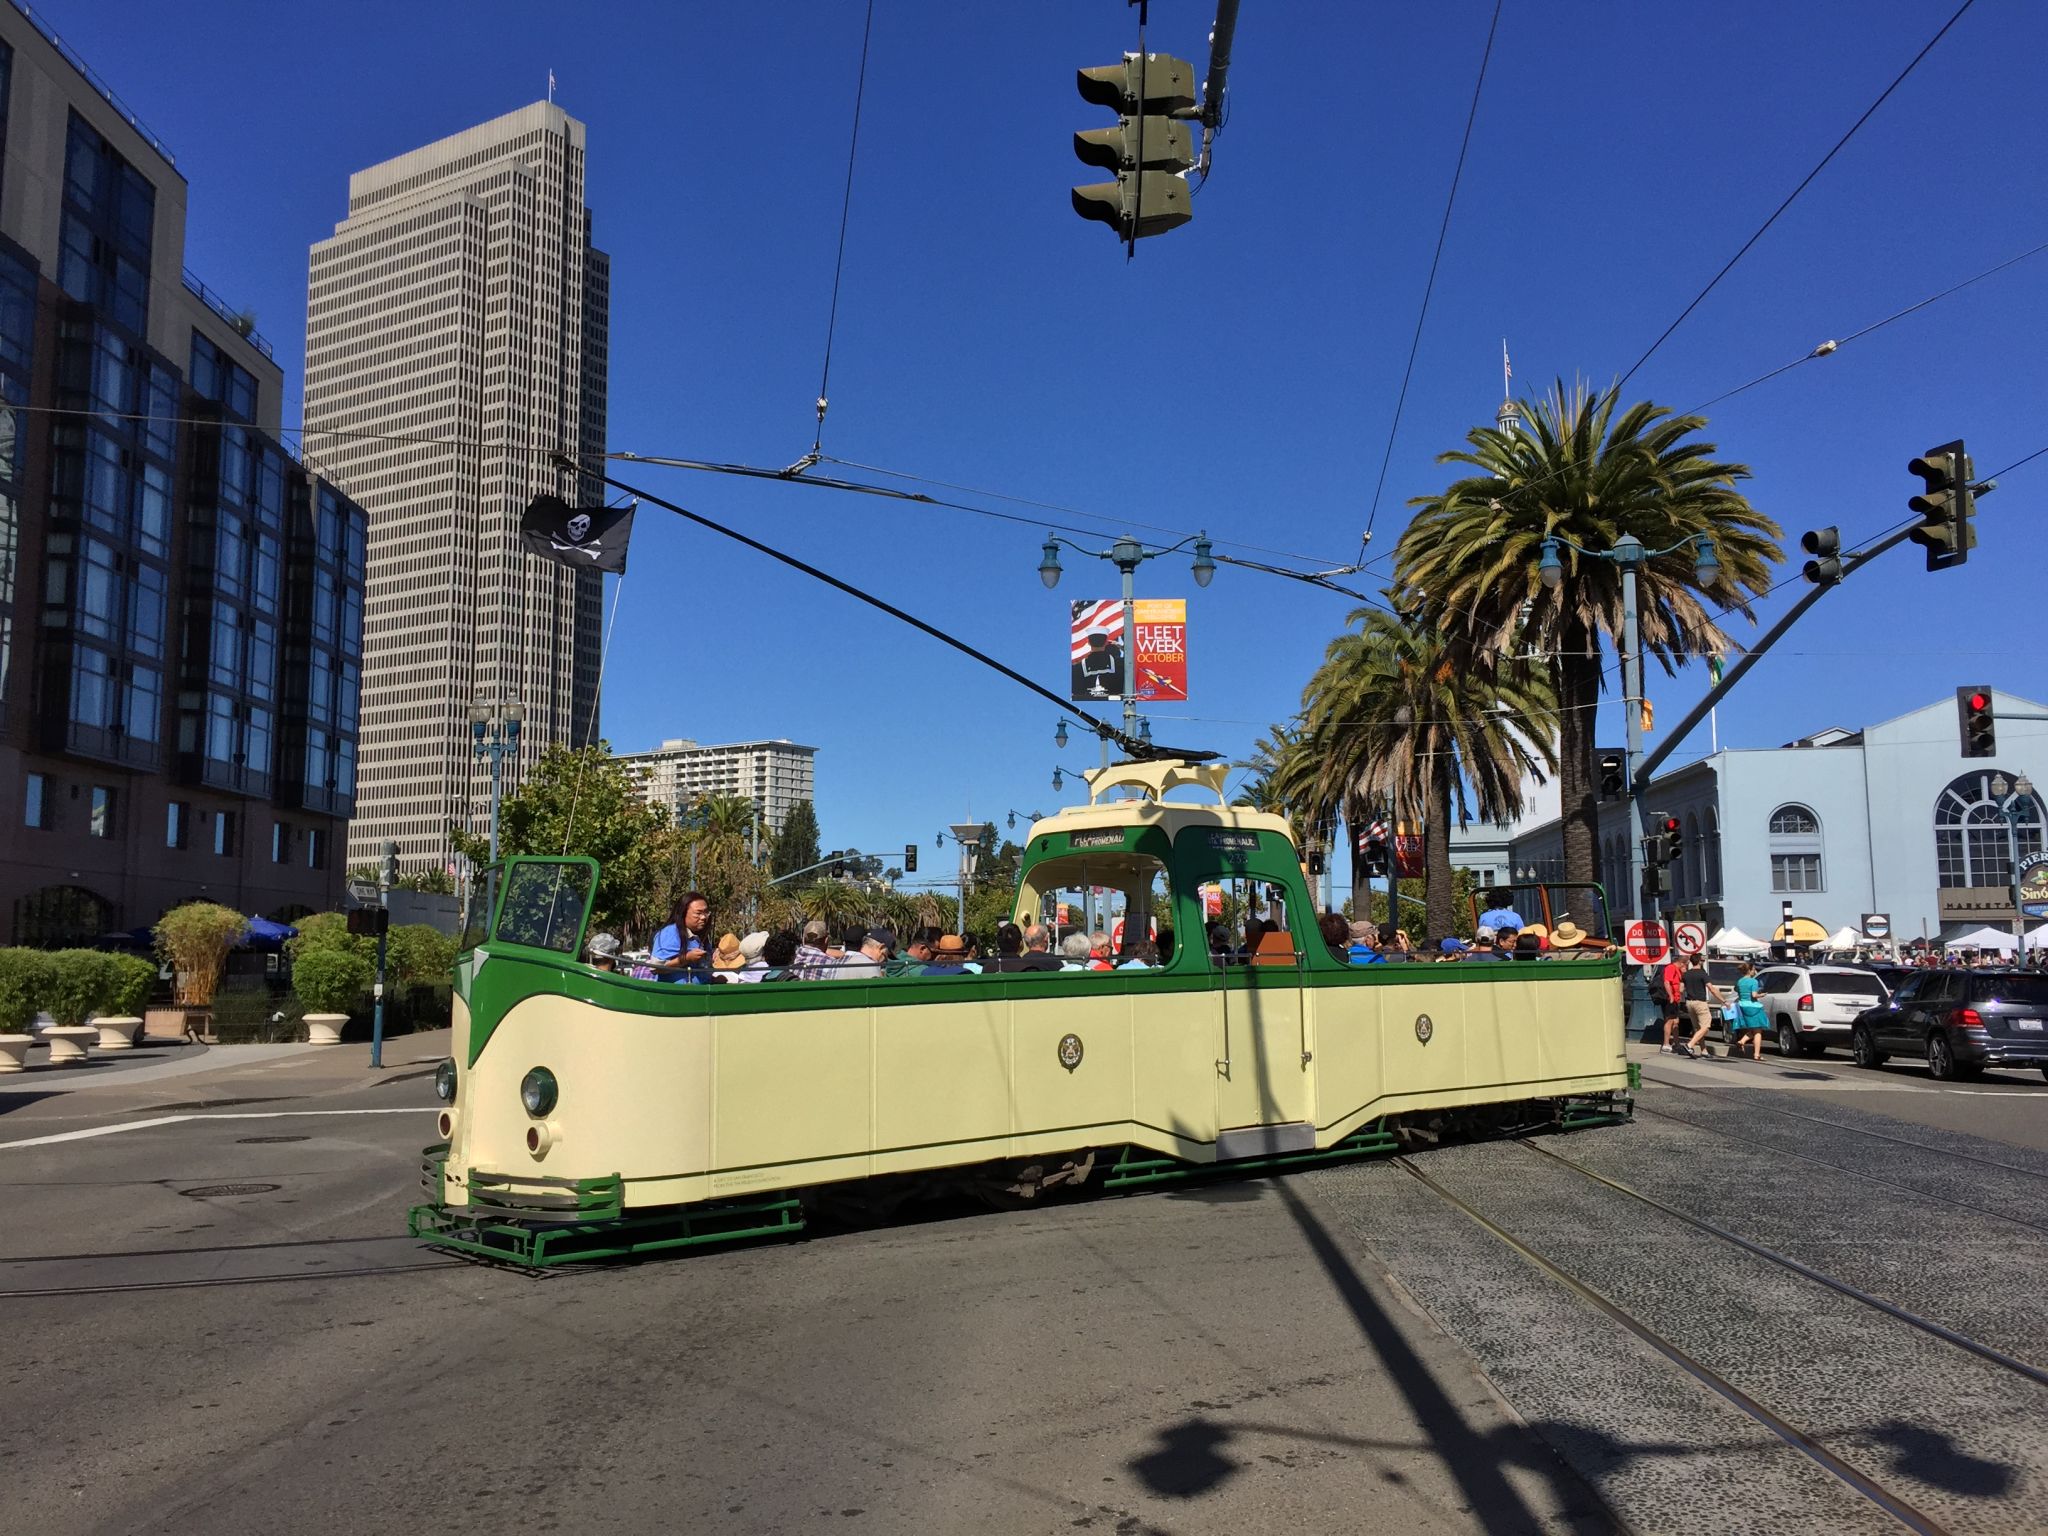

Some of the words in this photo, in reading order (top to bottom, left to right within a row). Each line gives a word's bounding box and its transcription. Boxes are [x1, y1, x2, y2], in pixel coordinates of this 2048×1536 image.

[1136, 626, 1183, 639] FLEET
[1136, 639, 1184, 652] WEEK
[1137, 653, 1184, 662] OCTOBER
[2020, 852, 2048, 870] PIER
[1636, 948, 1660, 956] ENTER
